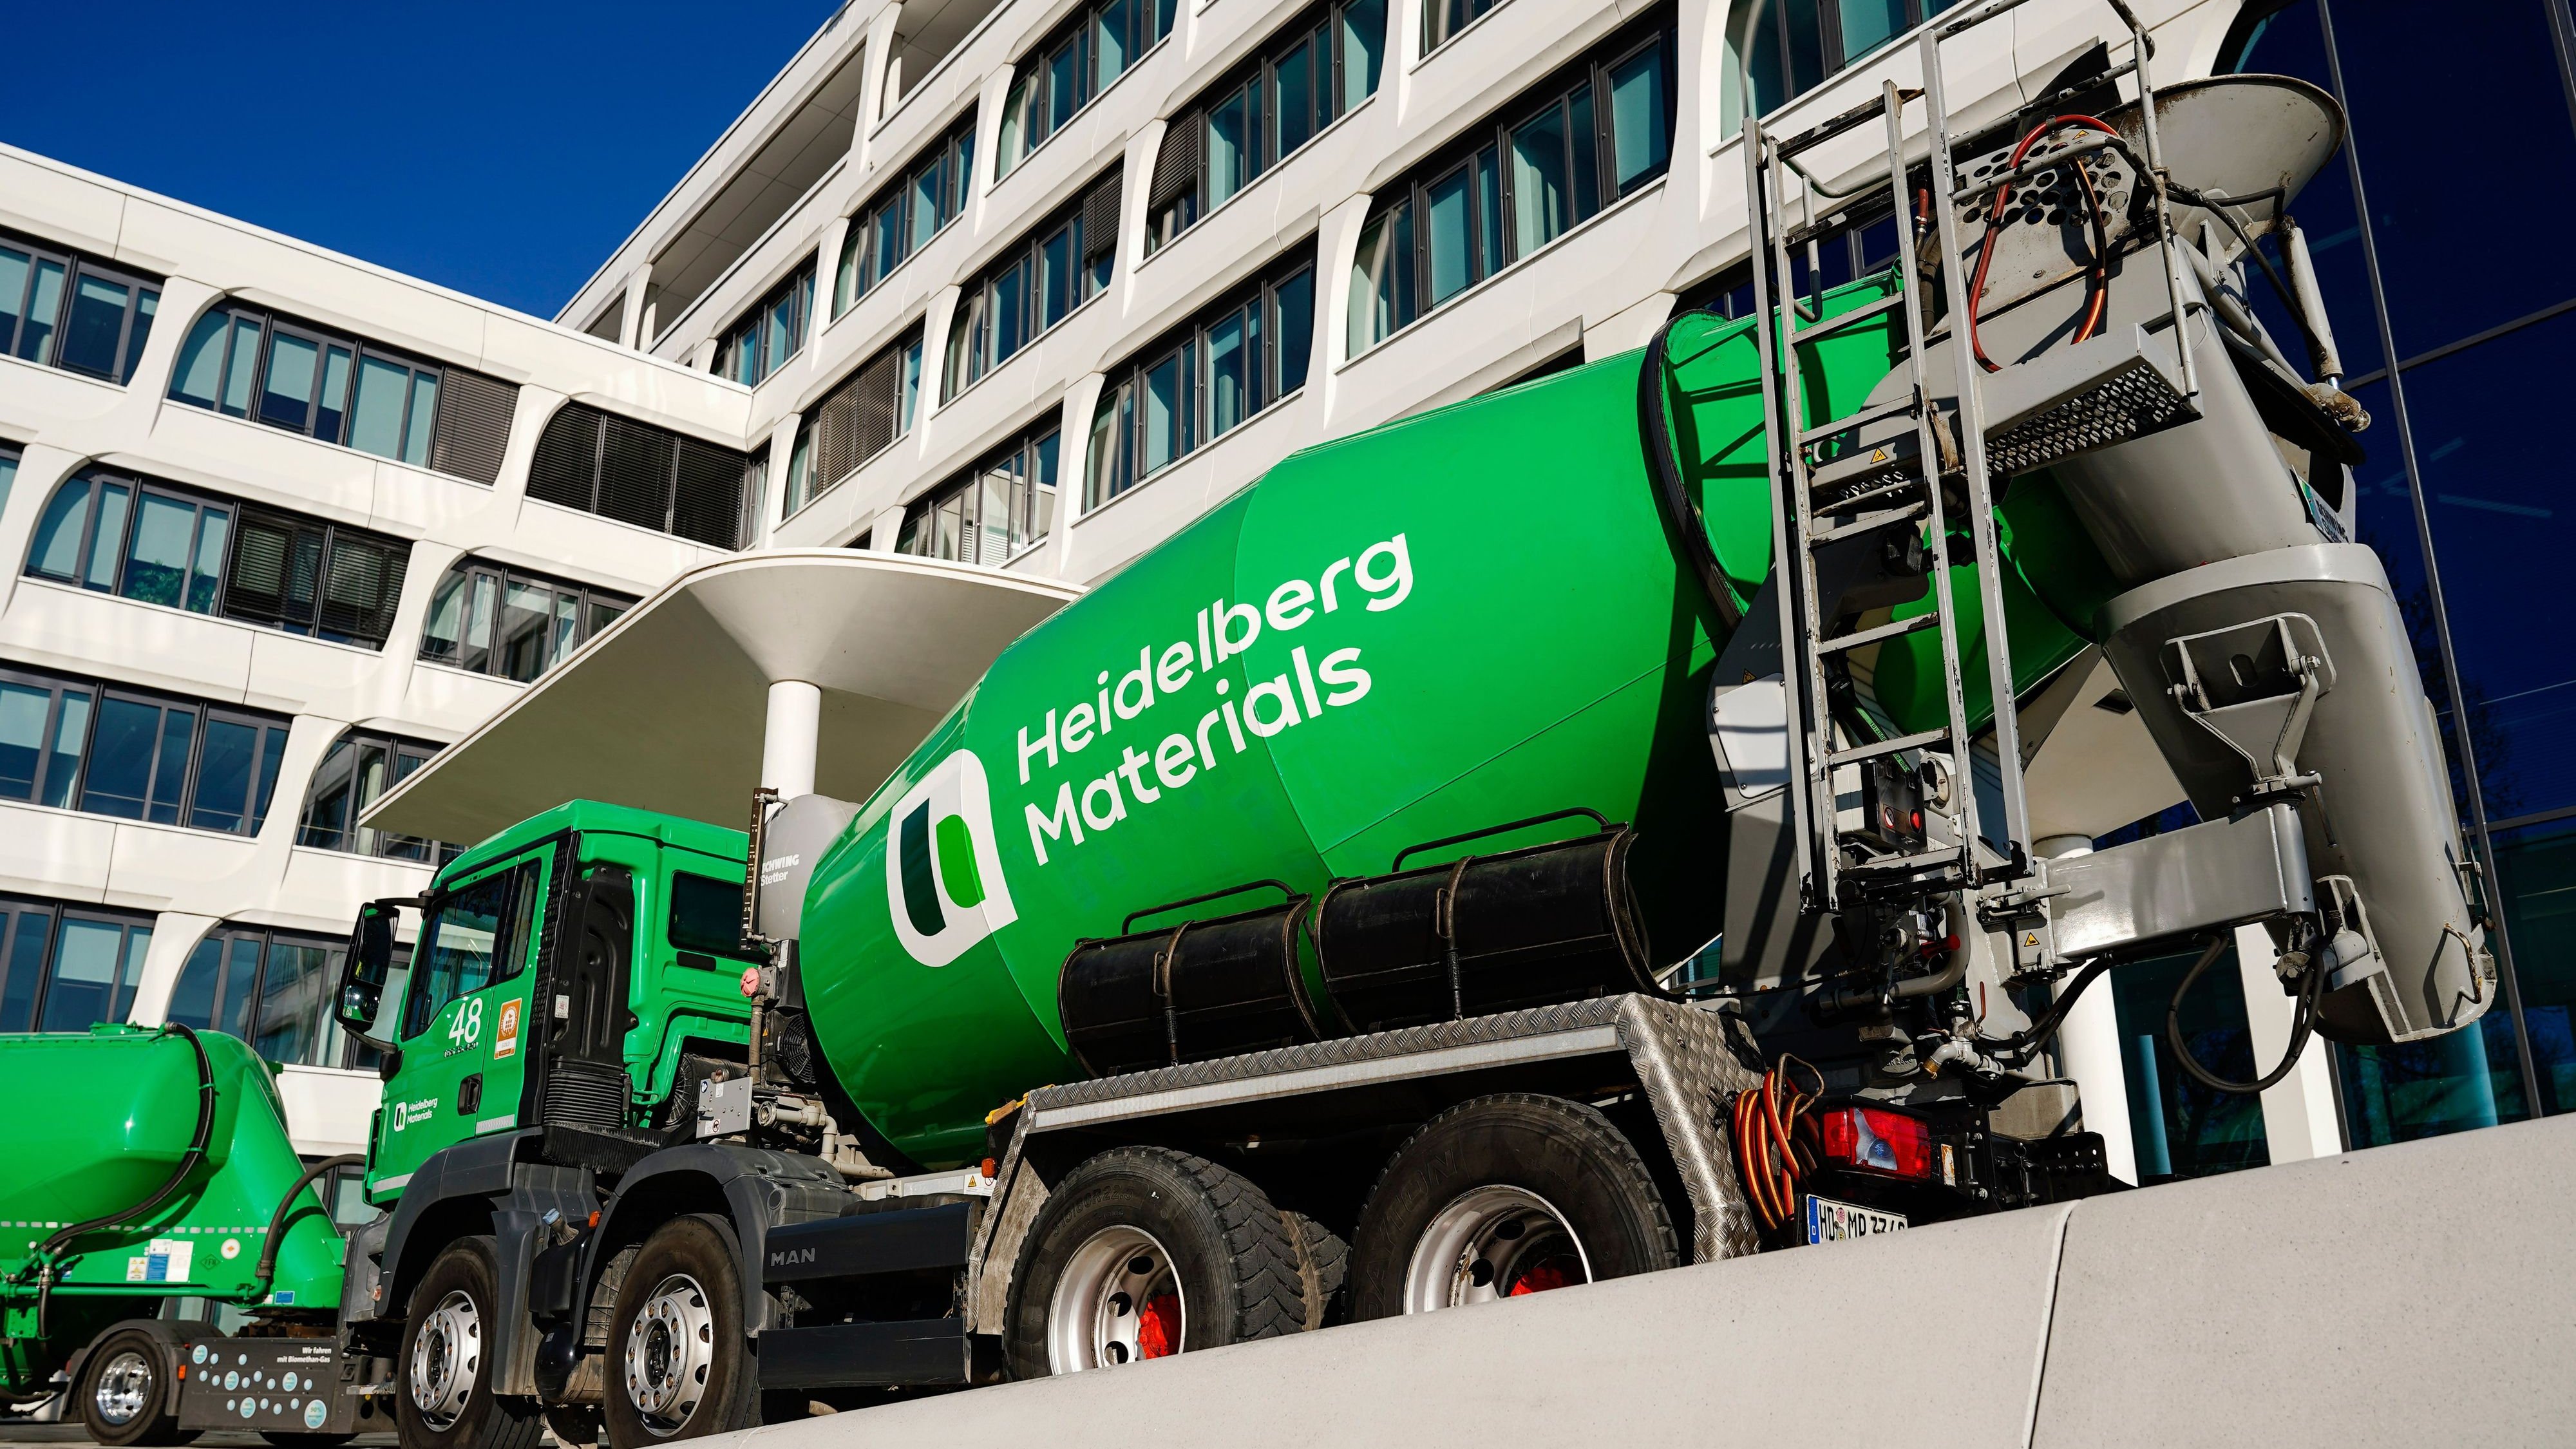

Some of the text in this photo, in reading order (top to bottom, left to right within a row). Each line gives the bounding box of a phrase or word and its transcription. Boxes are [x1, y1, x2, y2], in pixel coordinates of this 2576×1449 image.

[1017, 533, 1413, 785] Heidelberg
[1024, 645, 1372, 866] Materials
[761, 871, 789, 887] Stetter
[448, 998, 483, 1046] 48
[406, 1108, 433, 1124] Materials
[408, 1097, 438, 1113] Heidelberg
[1819, 1203, 1835, 1242] HD
[770, 1247, 815, 1267] MAN
